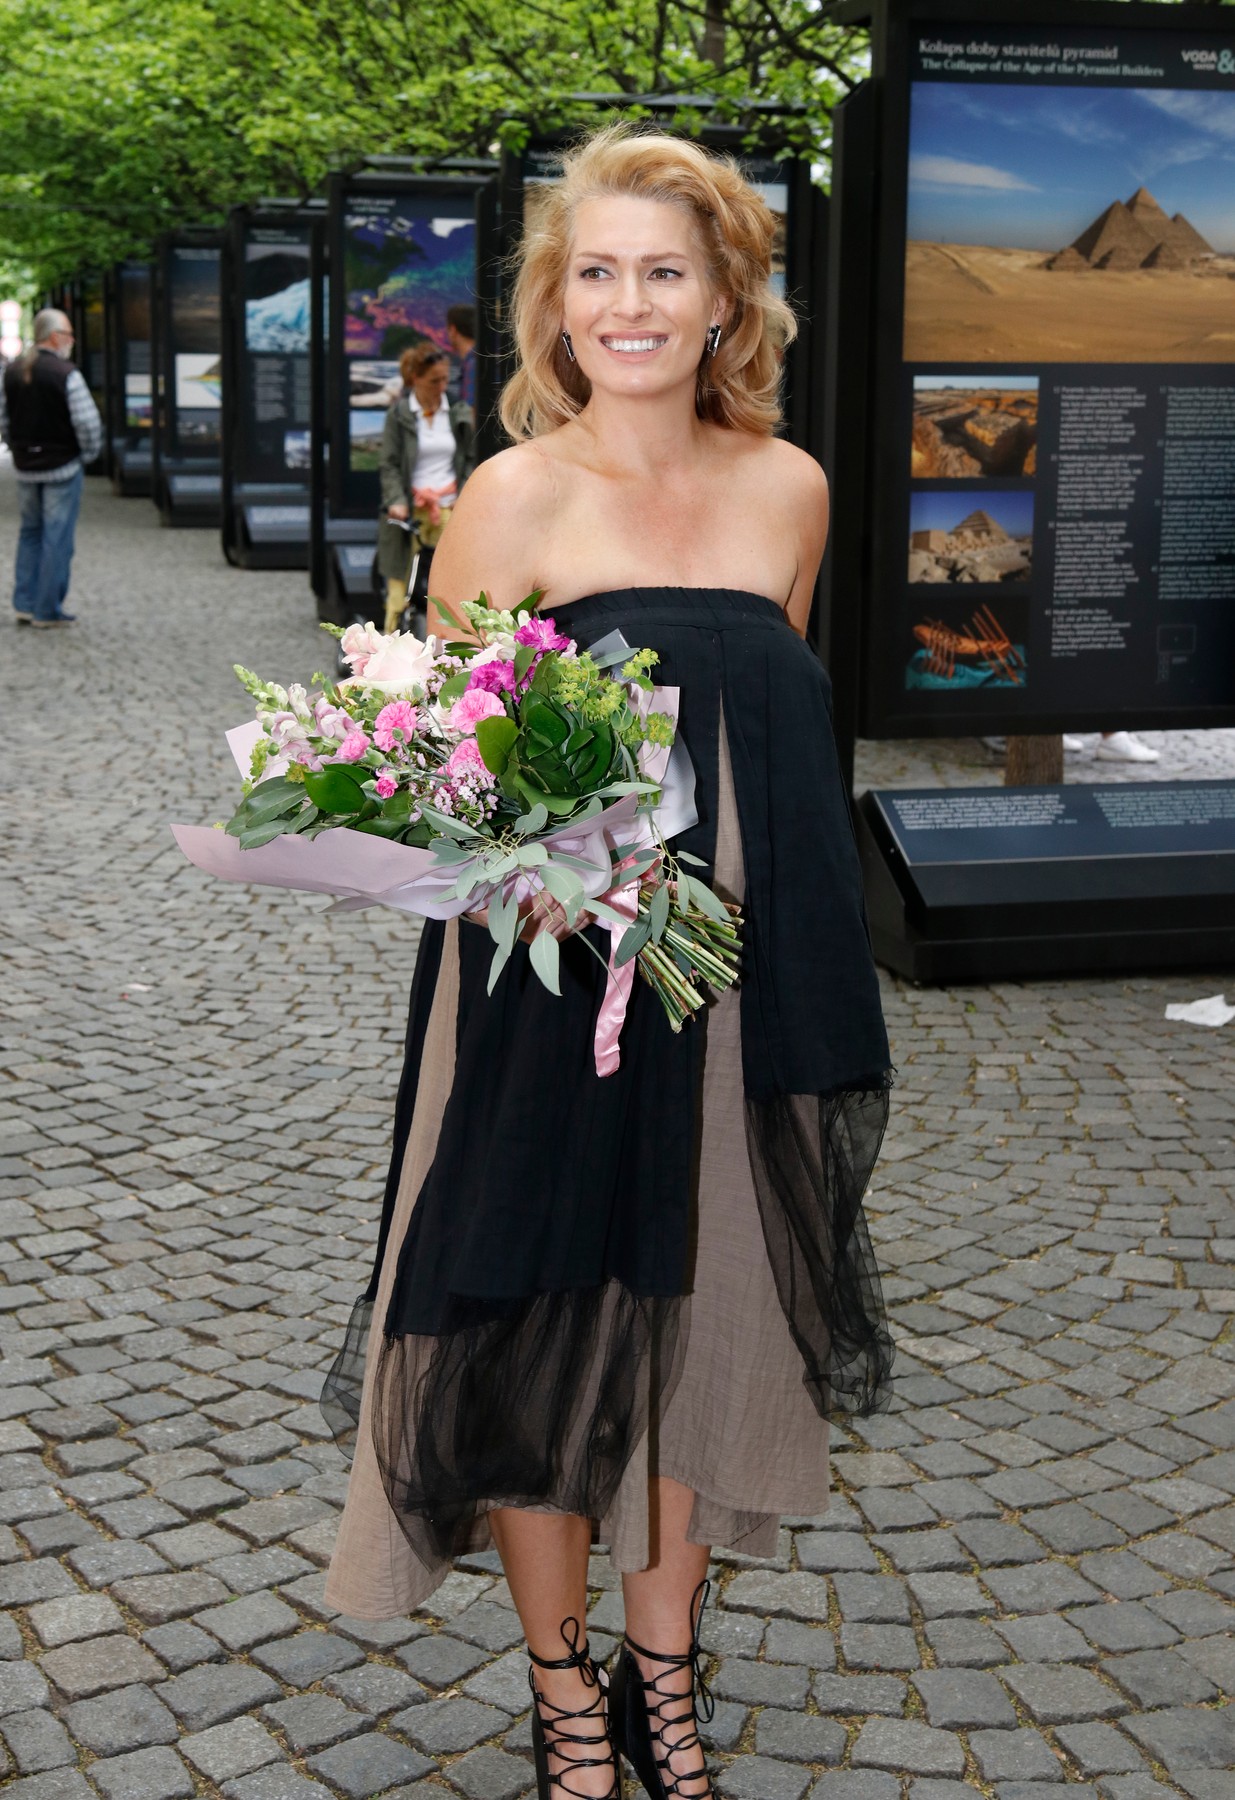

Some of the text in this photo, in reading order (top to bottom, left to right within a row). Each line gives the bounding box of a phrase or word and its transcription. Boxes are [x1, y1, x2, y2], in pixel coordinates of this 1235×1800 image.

[966, 41, 999, 58] doby
[1063, 45, 1118, 61] pyramid
[1181, 50, 1217, 62] VODA
[921, 58, 1164, 77] The Collapse of the Age of the Pyramid Builders
